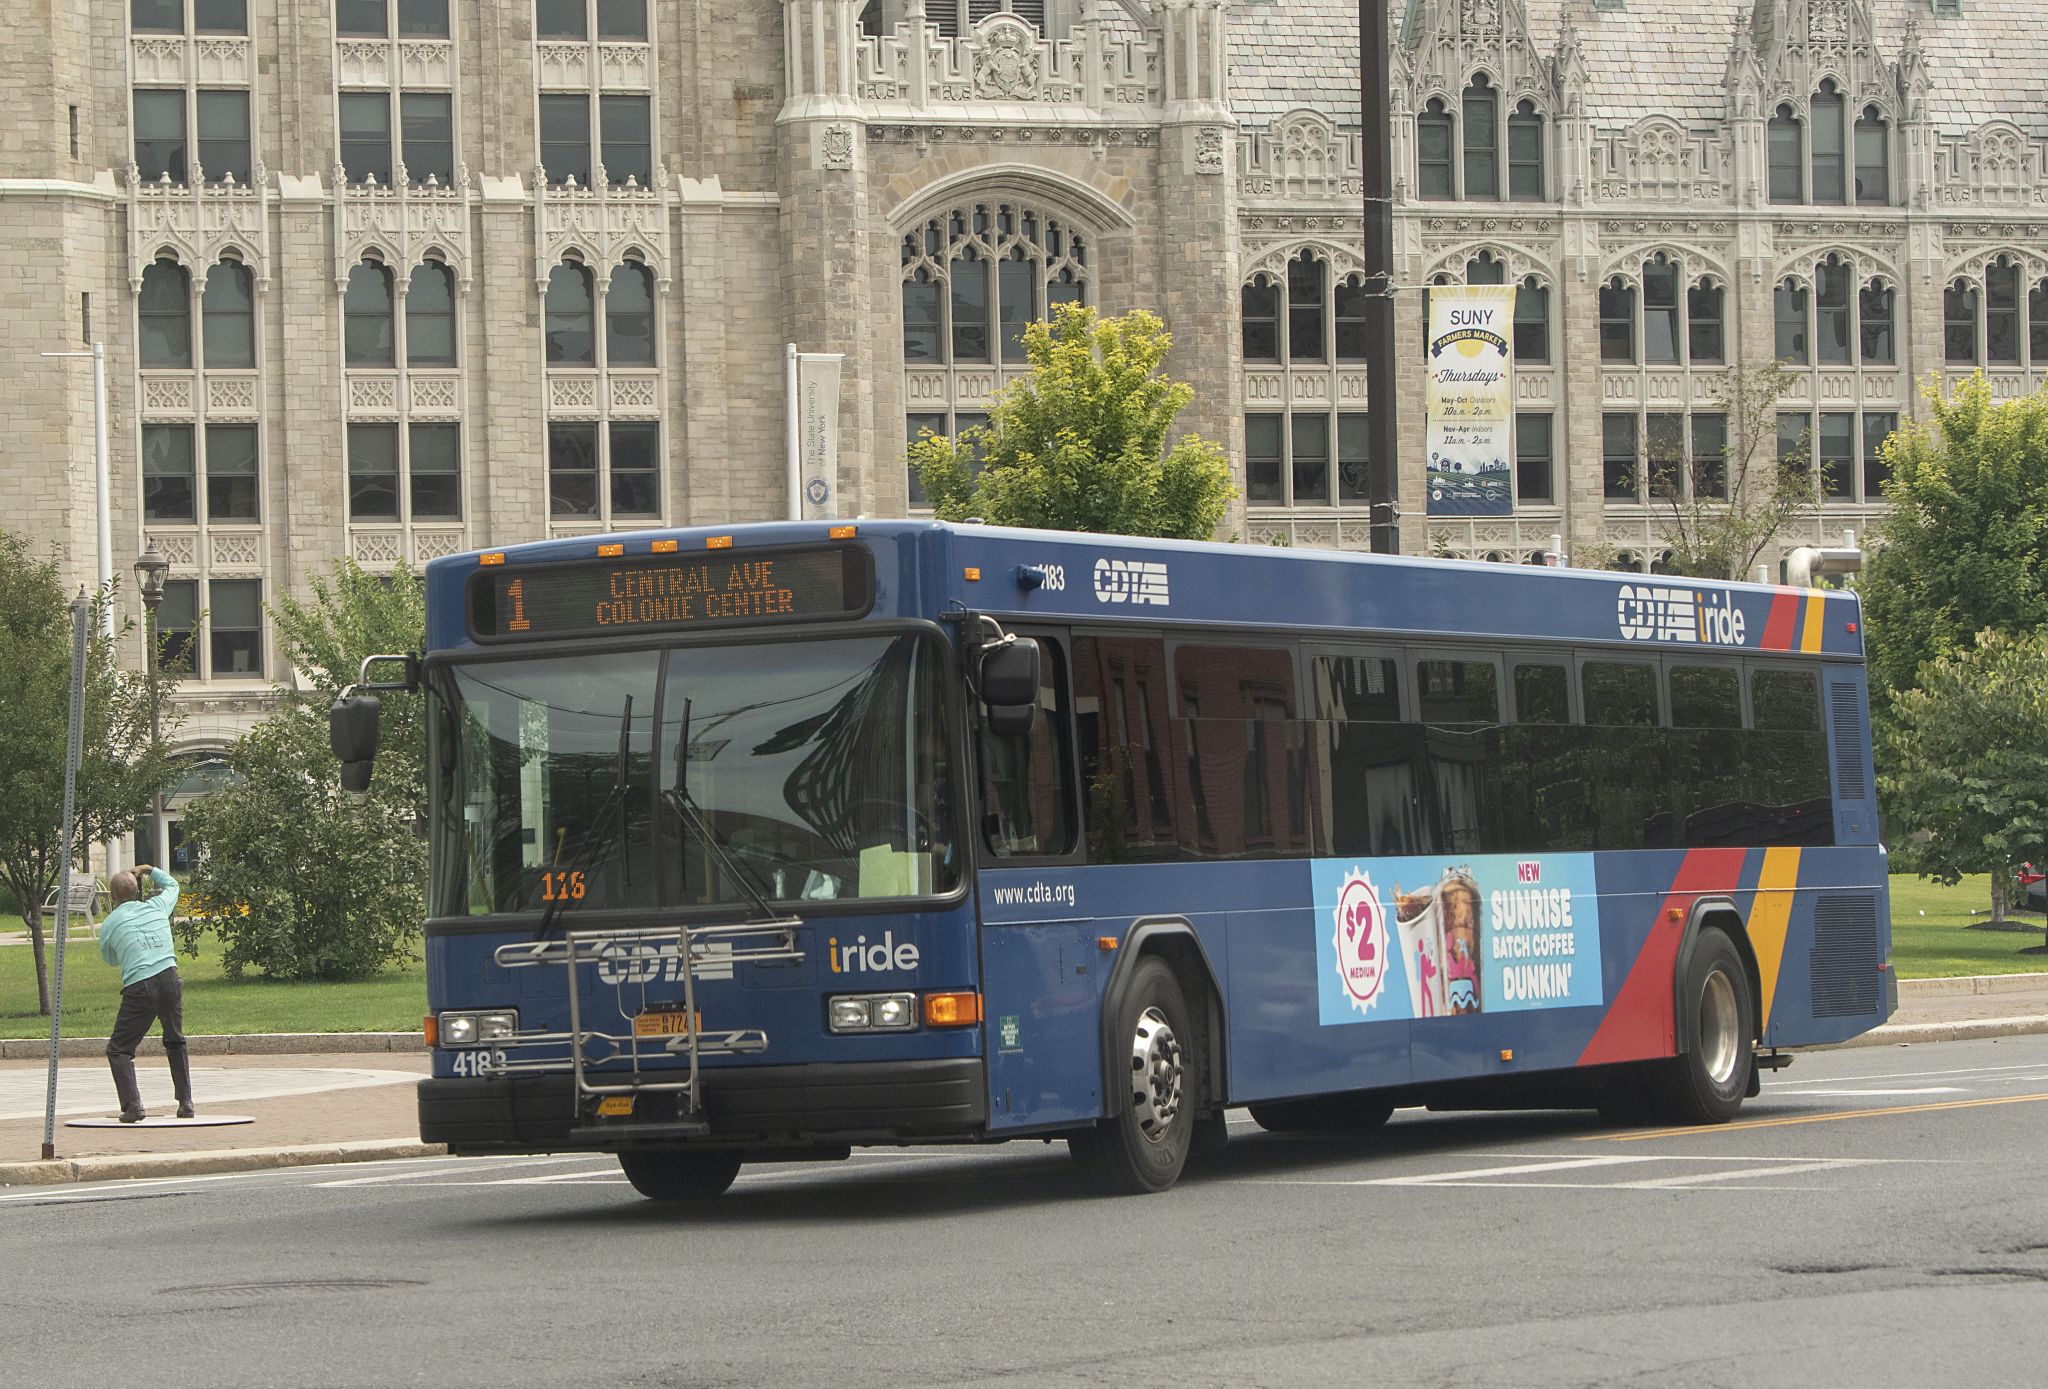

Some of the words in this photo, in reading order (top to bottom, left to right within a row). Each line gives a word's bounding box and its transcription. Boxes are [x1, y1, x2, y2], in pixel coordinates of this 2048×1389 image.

[1450, 309, 1494, 325] SUNY
[1438, 330, 1472, 347] FARMERS
[1473, 330, 1503, 347] MARKET
[1438, 368, 1499, 386] Thursdays
[807, 381, 818, 424] University
[1441, 396, 1468, 405] May-Oct
[807, 425, 816, 447] State
[818, 415, 826, 434] York
[1443, 425, 1470, 435] Nov-Apr
[807, 449, 815, 466] The
[818, 436, 826, 456] New
[609, 566, 715, 599] CENTRAL
[727, 561, 775, 590] AVE
[1038, 563, 1065, 592] 183
[1093, 558, 1170, 606] CDTA
[506, 578, 531, 631] 1
[596, 595, 695, 625] COLONIE
[706, 588, 794, 618] CENTER
[1618, 585, 1697, 642] CDTA
[1697, 590, 1746, 646] iride
[1518, 863, 1540, 883] NEW
[993, 880, 1075, 907] www.cdta.org
[1491, 888, 1573, 931] SUNRISE
[1346, 900, 1376, 961] $2
[829, 931, 920, 973] iride
[1492, 935, 1530, 960] BATCH
[1532, 933, 1575, 958] COFFEE
[1350, 965, 1376, 979] MEDIUM
[1503, 963, 1572, 1001] DUNKIN'
